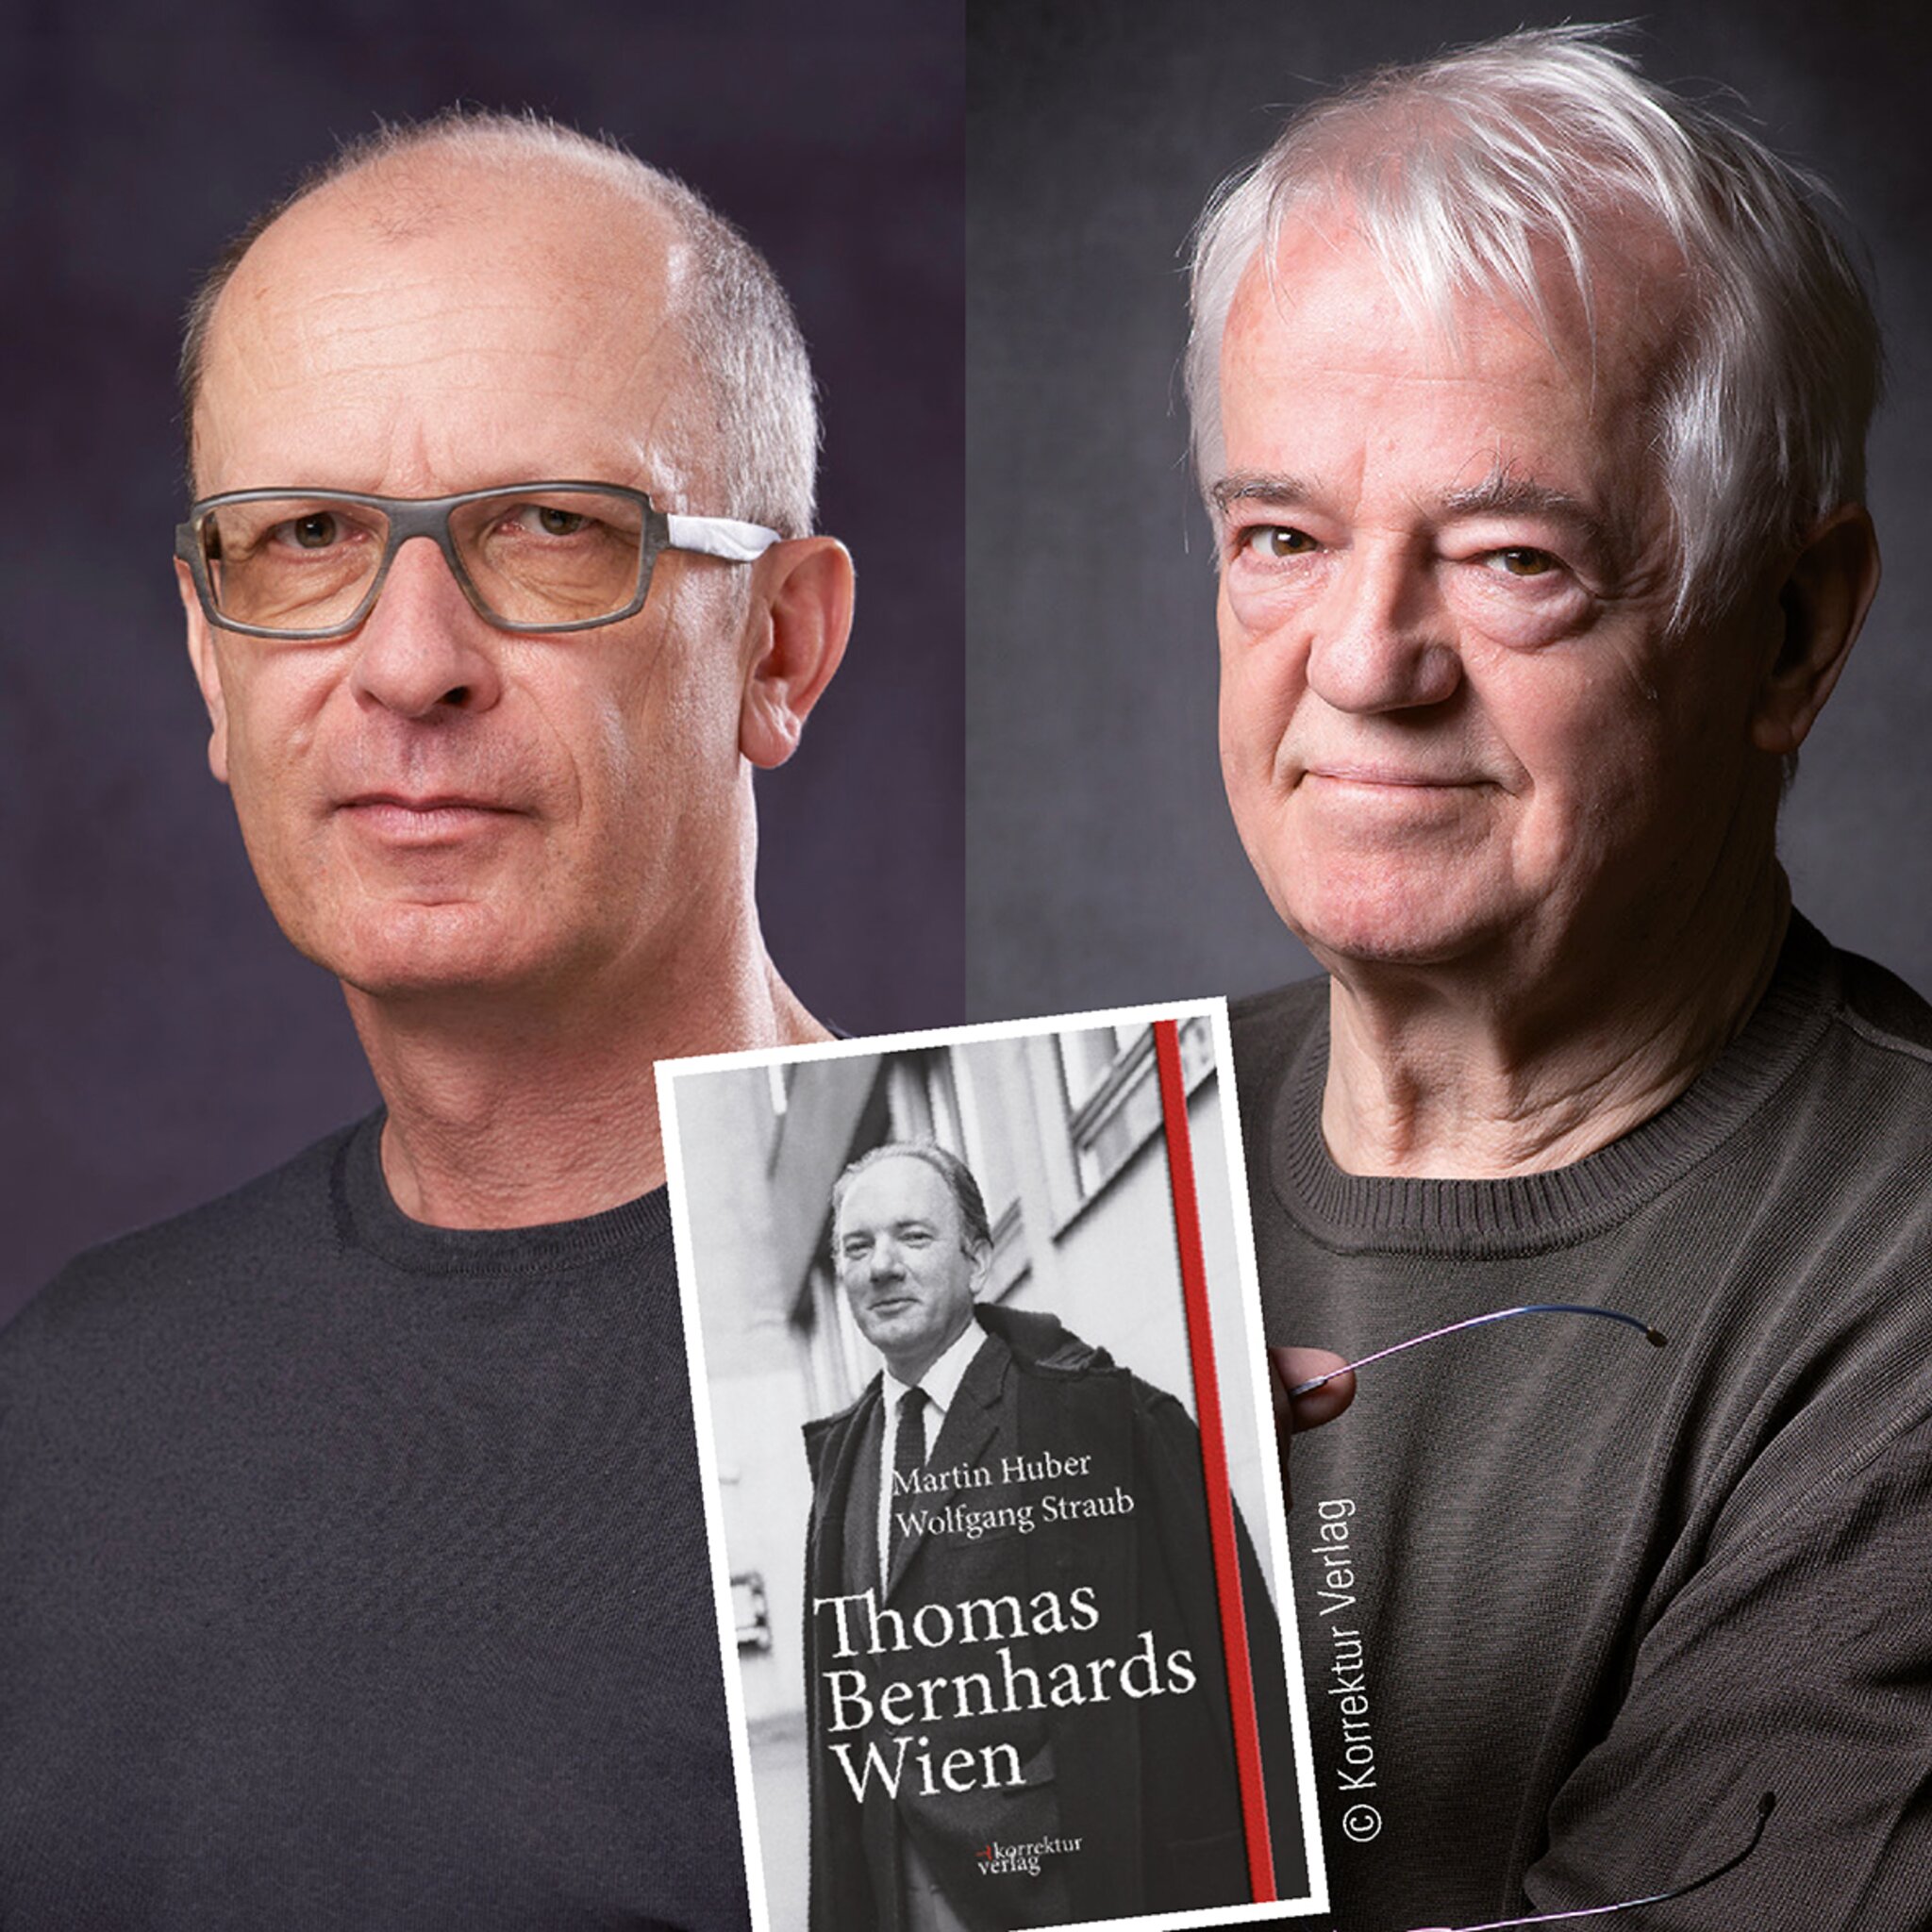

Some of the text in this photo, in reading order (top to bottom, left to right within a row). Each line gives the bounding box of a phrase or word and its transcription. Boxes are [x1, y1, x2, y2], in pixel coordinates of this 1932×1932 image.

[891, 1452, 1091, 1496] Martin Huber
[895, 1488, 1135, 1540] Wolfgang Straub
[814, 1586, 1100, 1658] Thomas
[823, 1631, 1197, 1732] Bernhards
[828, 1736, 1026, 1804] Wien
[977, 1853, 1041, 1876] verlag
[993, 1835, 1082, 1859] korrektur
